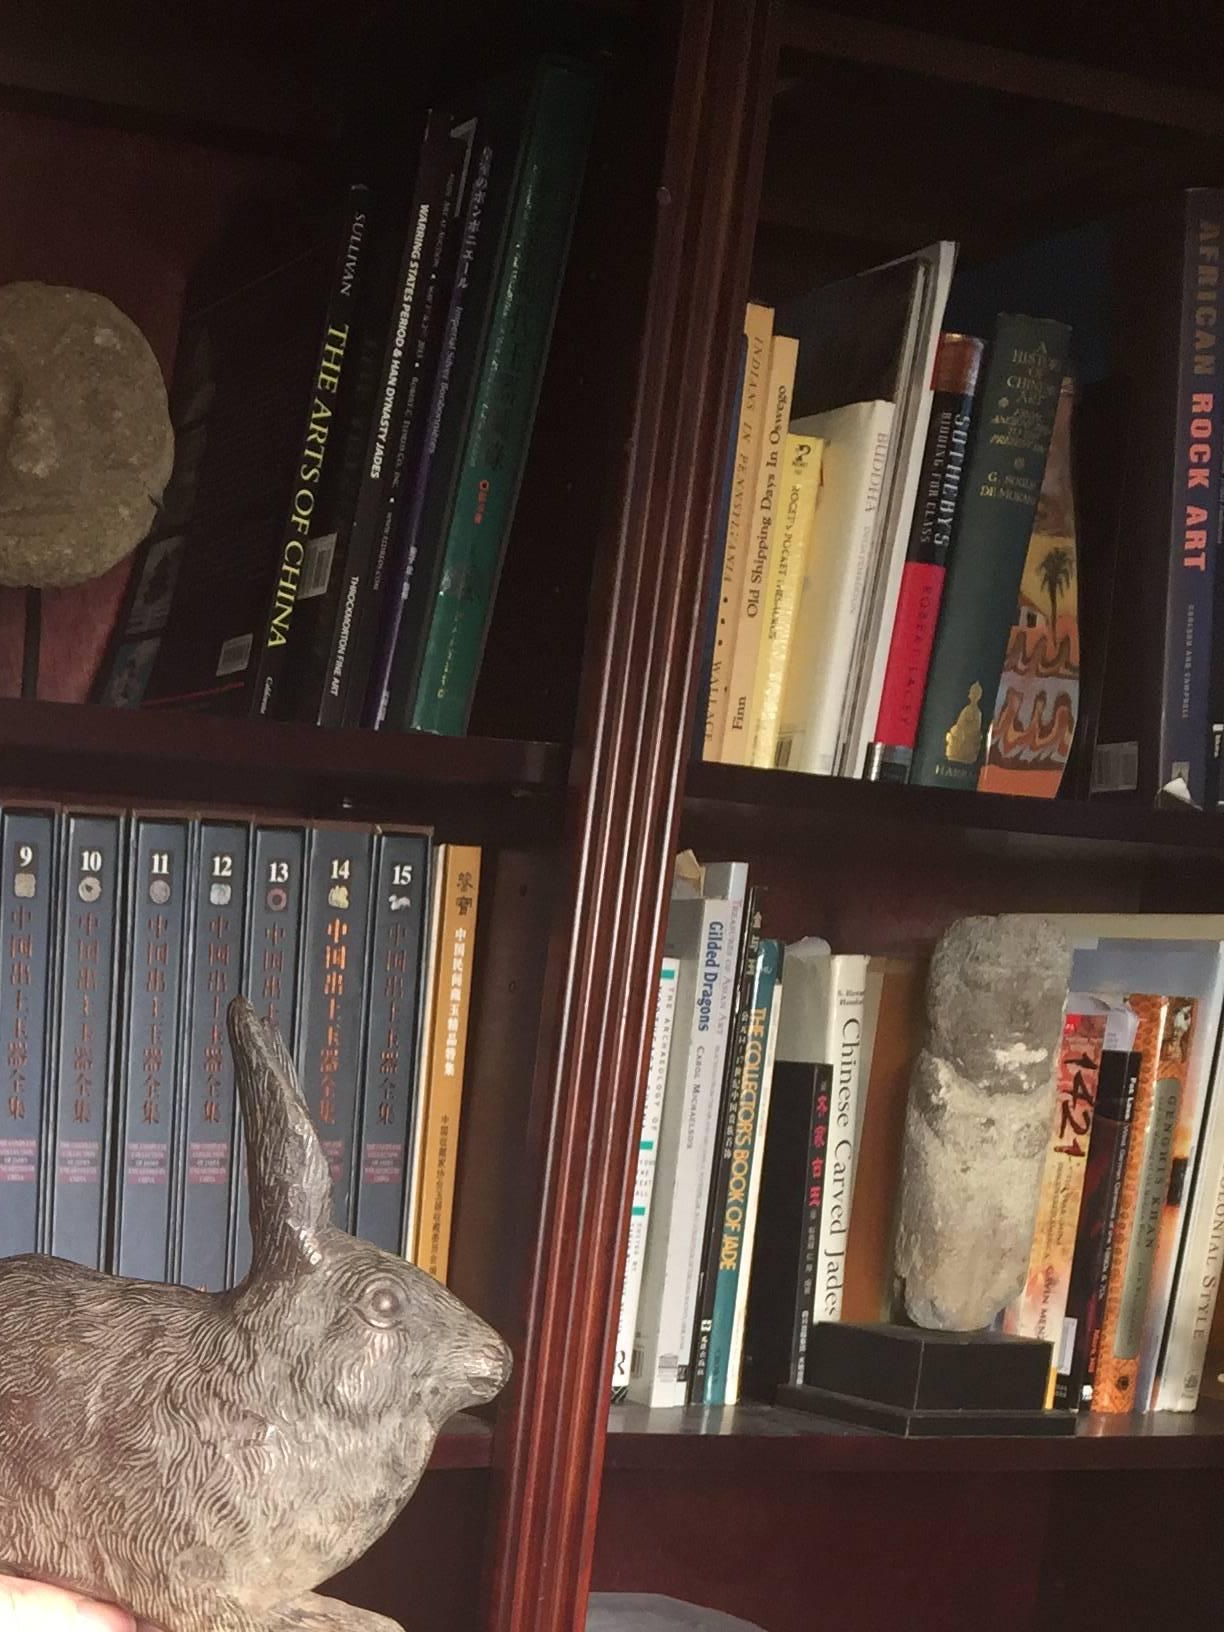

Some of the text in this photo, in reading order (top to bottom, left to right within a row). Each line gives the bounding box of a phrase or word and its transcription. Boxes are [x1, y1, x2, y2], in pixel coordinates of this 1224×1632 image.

[338, 210, 367, 297] SULLIVAN
[409, 202, 429, 259] WARRING
[401, 260, 419, 302] STATES
[393, 302, 411, 348] PERIOD
[386, 358, 401, 385] HAN
[745, 335, 764, 410] INDIANS
[376, 386, 396, 442] DYNASTY
[1183, 220, 1222, 571] AFRICAN ROCK ART
[741, 421, 753, 442] IN
[369, 442, 385, 479] JADES
[864, 431, 889, 512] BUDDHA
[918, 411, 953, 544] BIDDING FOR CLASS
[264, 320, 350, 650] THE ARTS OF CHINA
[745, 384, 788, 618] Old Shipping Days In Oswego
[778, 532, 793, 576] POCKET
[328, 575, 359, 696] THROCKMORTON FINE ART
[731, 694, 746, 730] Finn
[19, 845, 33, 867] 9
[81, 850, 102, 873] 10
[150, 853, 170, 875] 11
[212, 856, 232, 877] 12
[267, 862, 289, 883] 13
[330, 859, 351, 880] 14
[392, 865, 413, 885] 15
[704, 920, 725, 968] Gilded
[693, 970, 717, 1032] Dragons
[719, 975, 731, 1009] ASIAN
[748, 1006, 766, 1037] THE
[693, 1045, 704, 1078] CAROL
[835, 1017, 861, 1127] Chinese
[1054, 1052, 1098, 1158] 1421
[1154, 1094, 1176, 1185] GENGHIS
[727, 1148, 750, 1204] BOOK
[829, 1139, 852, 1236] Carved
[723, 1205, 743, 1231] OF
[1144, 1195, 1160, 1249] KHAN
[718, 1233, 739, 1271] JADE
[820, 1249, 845, 1315] Jades
[1041, 1264, 1054, 1304] GAVIN
[1192, 1275, 1216, 1340] STYLE
